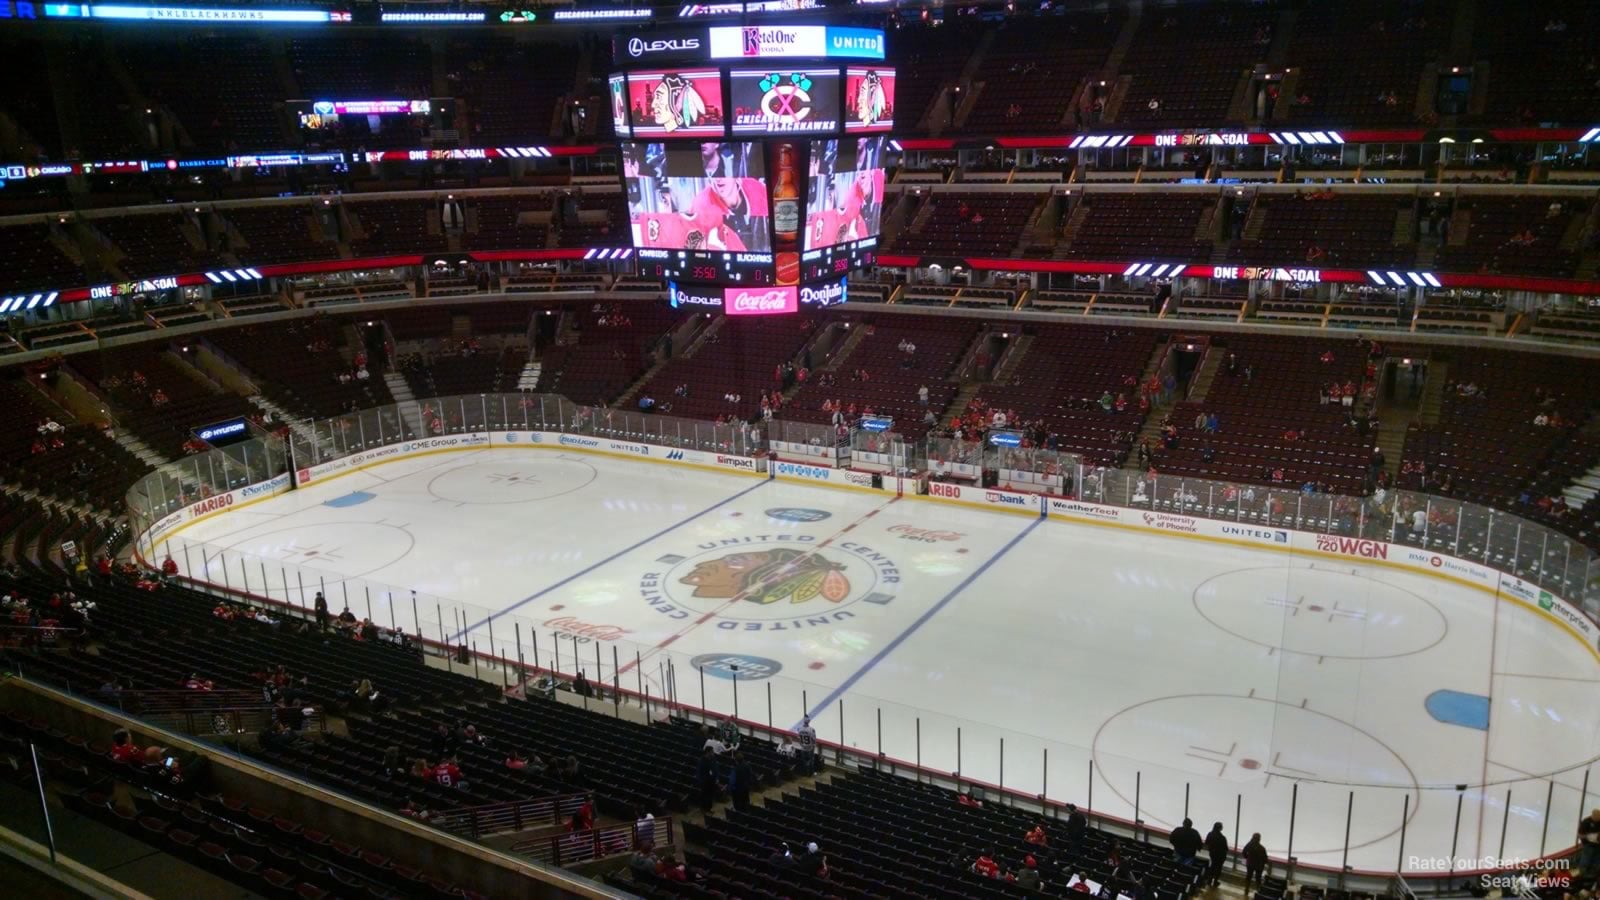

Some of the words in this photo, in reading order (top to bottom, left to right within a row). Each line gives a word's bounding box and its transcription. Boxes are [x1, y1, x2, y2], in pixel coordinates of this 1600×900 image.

[644, 38, 700, 51] LEXUS
[833, 36, 877, 50] UNITED
[766, 121, 836, 132] BLACKHAWKS
[1155, 135, 1177, 146] ONE
[409, 150, 428, 160] ONE
[41, 166, 72, 175] CHICAGO
[1213, 266, 1238, 279] ONE
[90, 285, 113, 299] ONE
[685, 295, 722, 305] LEXUS
[213, 422, 245, 436] HYUNDAI
[411, 440, 430, 450] CME
[431, 438, 458, 447] Group
[610, 443, 640, 453] UNITED
[723, 456, 753, 468] impact
[928, 481, 961, 499] ARIBO
[193, 493, 233, 517] HARIBO
[1053, 500, 1119, 517] WeatherTech
[1156, 513, 1196, 526] University
[1165, 523, 1197, 533] Phoenix
[1222, 526, 1272, 539] UNITED
[1316, 540, 1338, 552] 720
[1339, 538, 1388, 560] WGN
[698, 534, 816, 550] UNITED
[840, 541, 900, 585] CENTER
[640, 571, 690, 620] CENTER
[716, 610, 856, 632] UNITED
